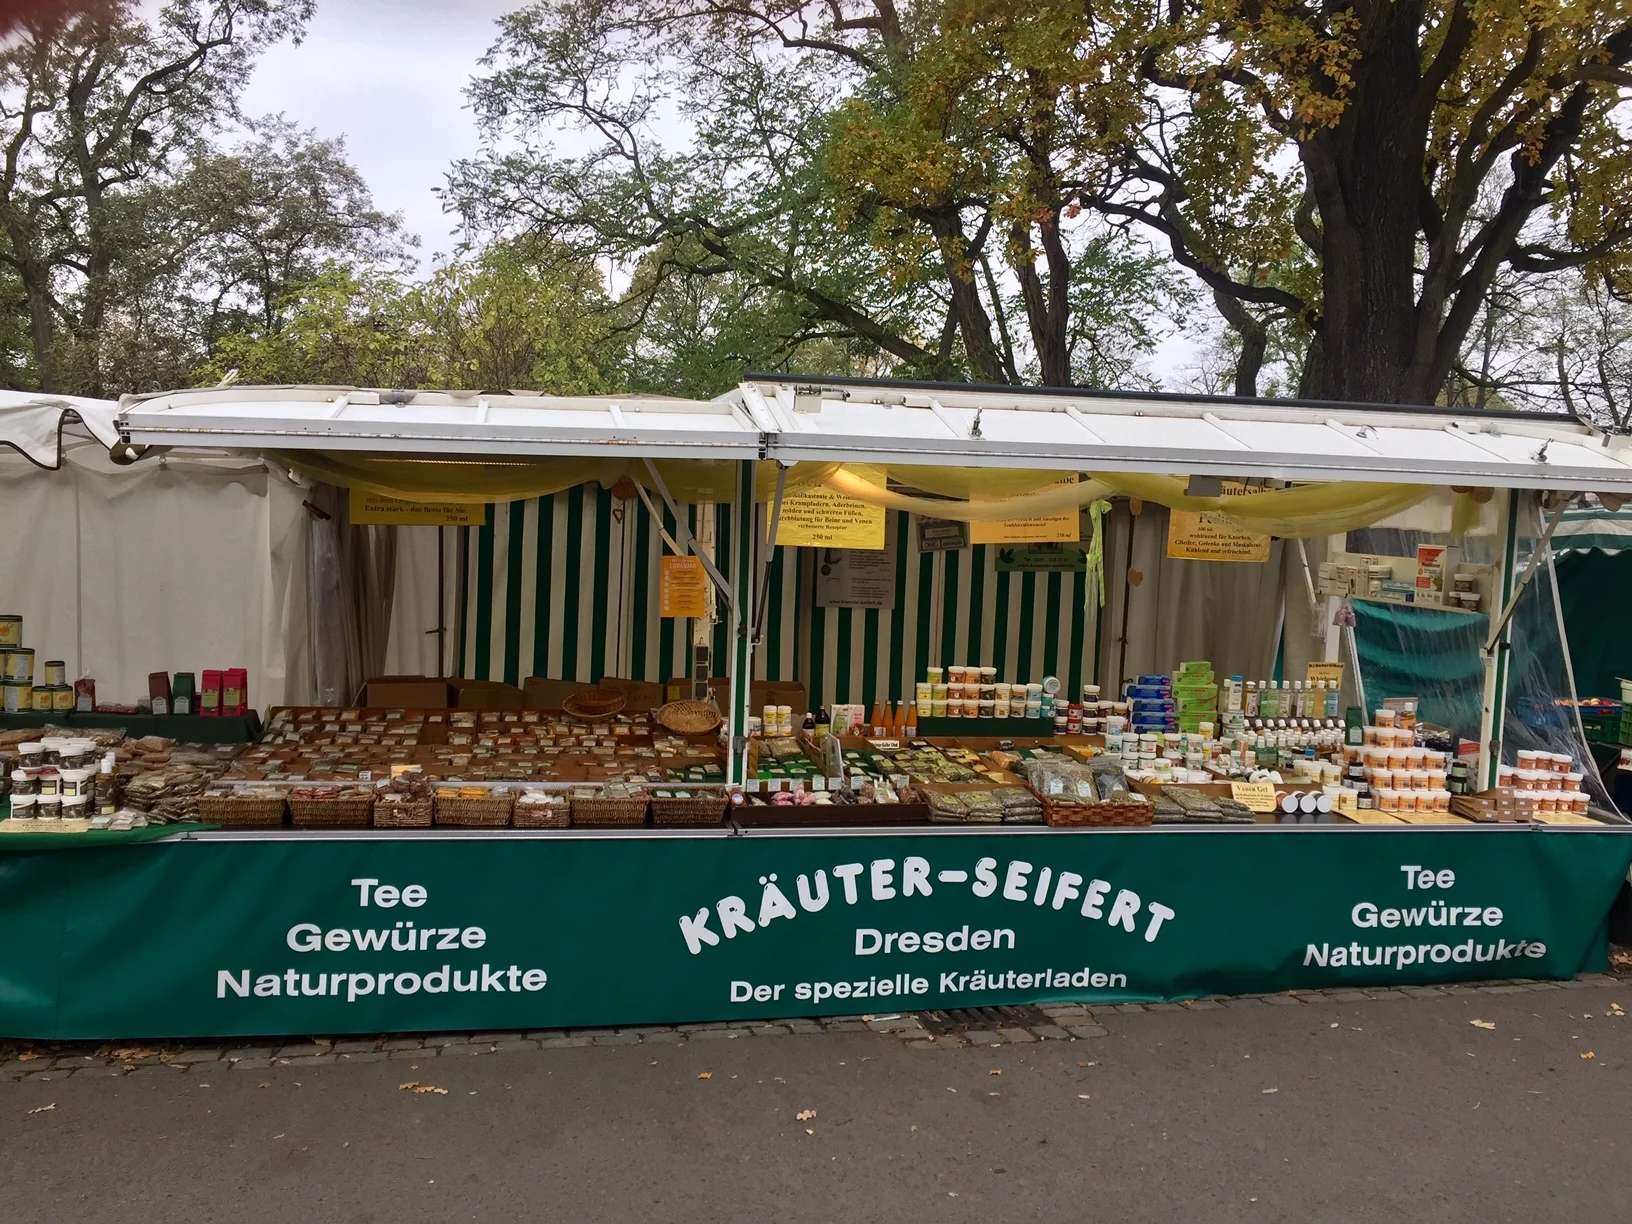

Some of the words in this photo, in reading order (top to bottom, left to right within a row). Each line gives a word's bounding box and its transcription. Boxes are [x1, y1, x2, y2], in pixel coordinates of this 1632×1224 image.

[790, 500, 831, 509] Krampfadern,
[814, 515, 823, 523] für
[812, 533, 824, 541] 250
[1185, 546, 1210, 554] Kühlend
[1400, 865, 1456, 890] Tee
[351, 878, 428, 908] Tee
[679, 856, 1176, 955] KRÄUTER-SEIFERT
[1351, 900, 1504, 929] Gewürze
[286, 921, 488, 953] Gewürze
[854, 925, 1016, 956] Dresden
[1303, 939, 1547, 971] Naturprodukte
[216, 964, 549, 1003] Naturprodukte
[729, 980, 786, 1003] Der
[793, 972, 930, 1004] spezielle
[938, 967, 1128, 994] Kräuterladen
